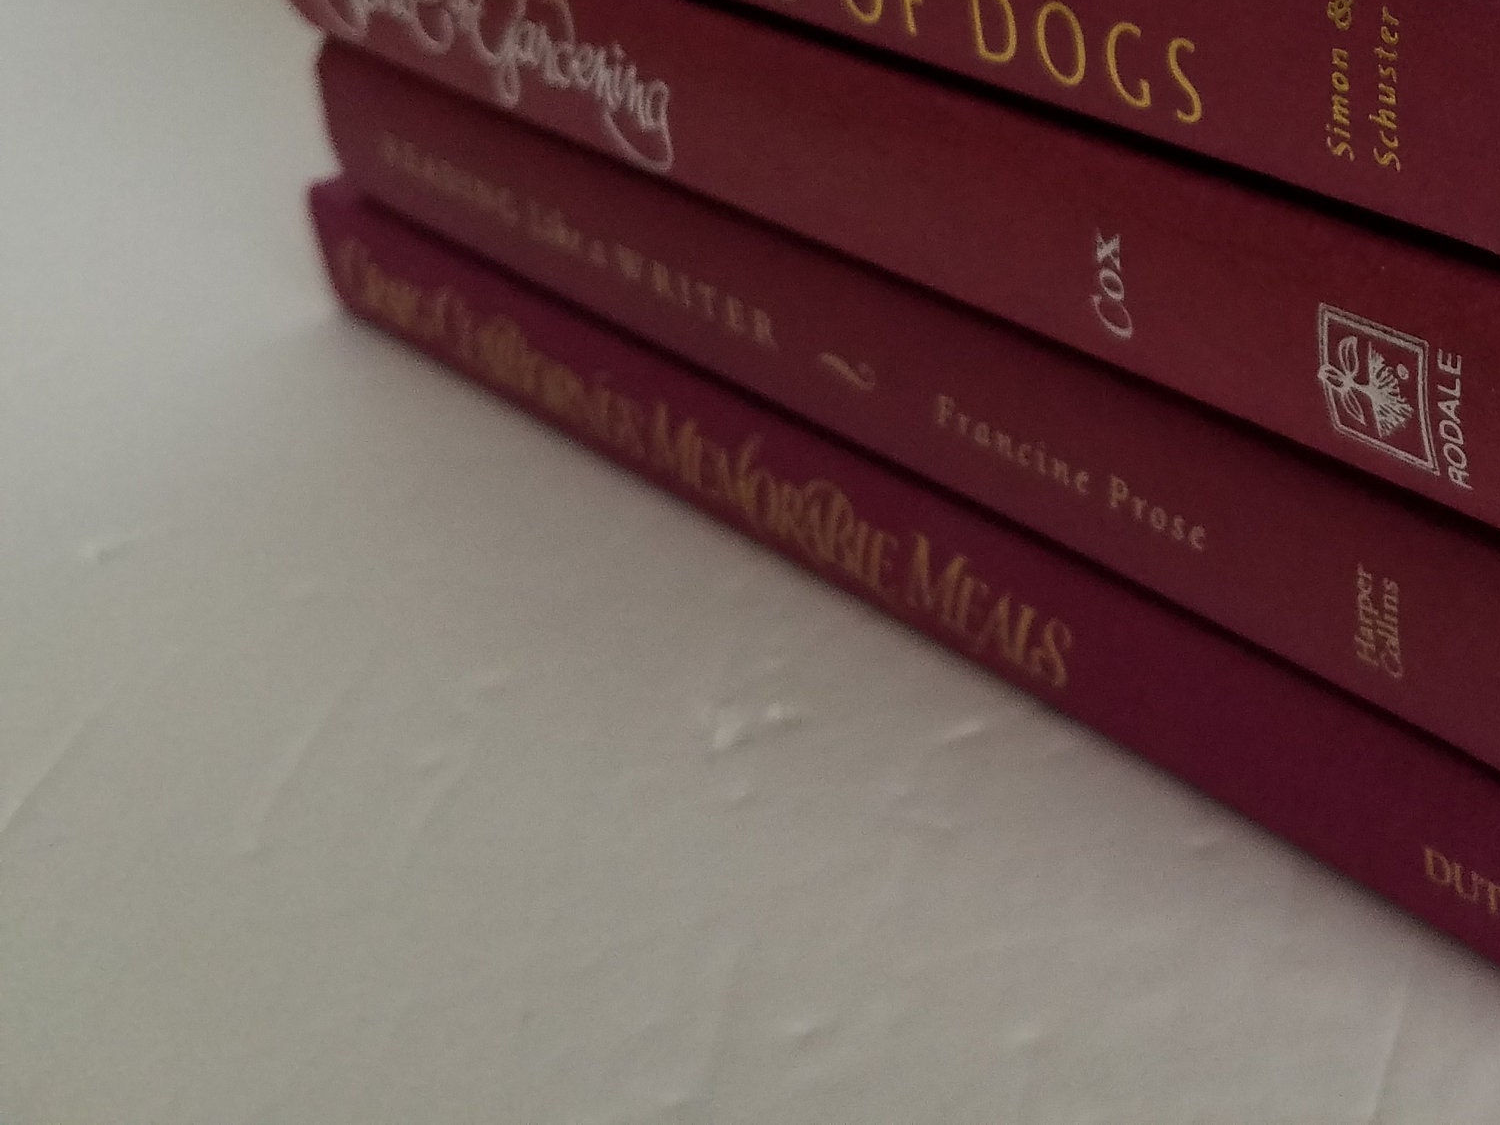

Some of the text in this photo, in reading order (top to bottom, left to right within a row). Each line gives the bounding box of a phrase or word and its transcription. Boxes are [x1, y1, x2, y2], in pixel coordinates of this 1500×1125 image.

[1325, 48, 1355, 162] Simon
[1368, 5, 1400, 172] Schuster
[612, 242, 782, 352] WRITER
[1091, 228, 1134, 340] Cox
[932, 393, 1208, 552] Francine Prose
[1436, 348, 1474, 490] RODALE
[906, 530, 1074, 690] MEALS
[1354, 562, 1380, 667] Harper
[1376, 577, 1404, 679] Collins
